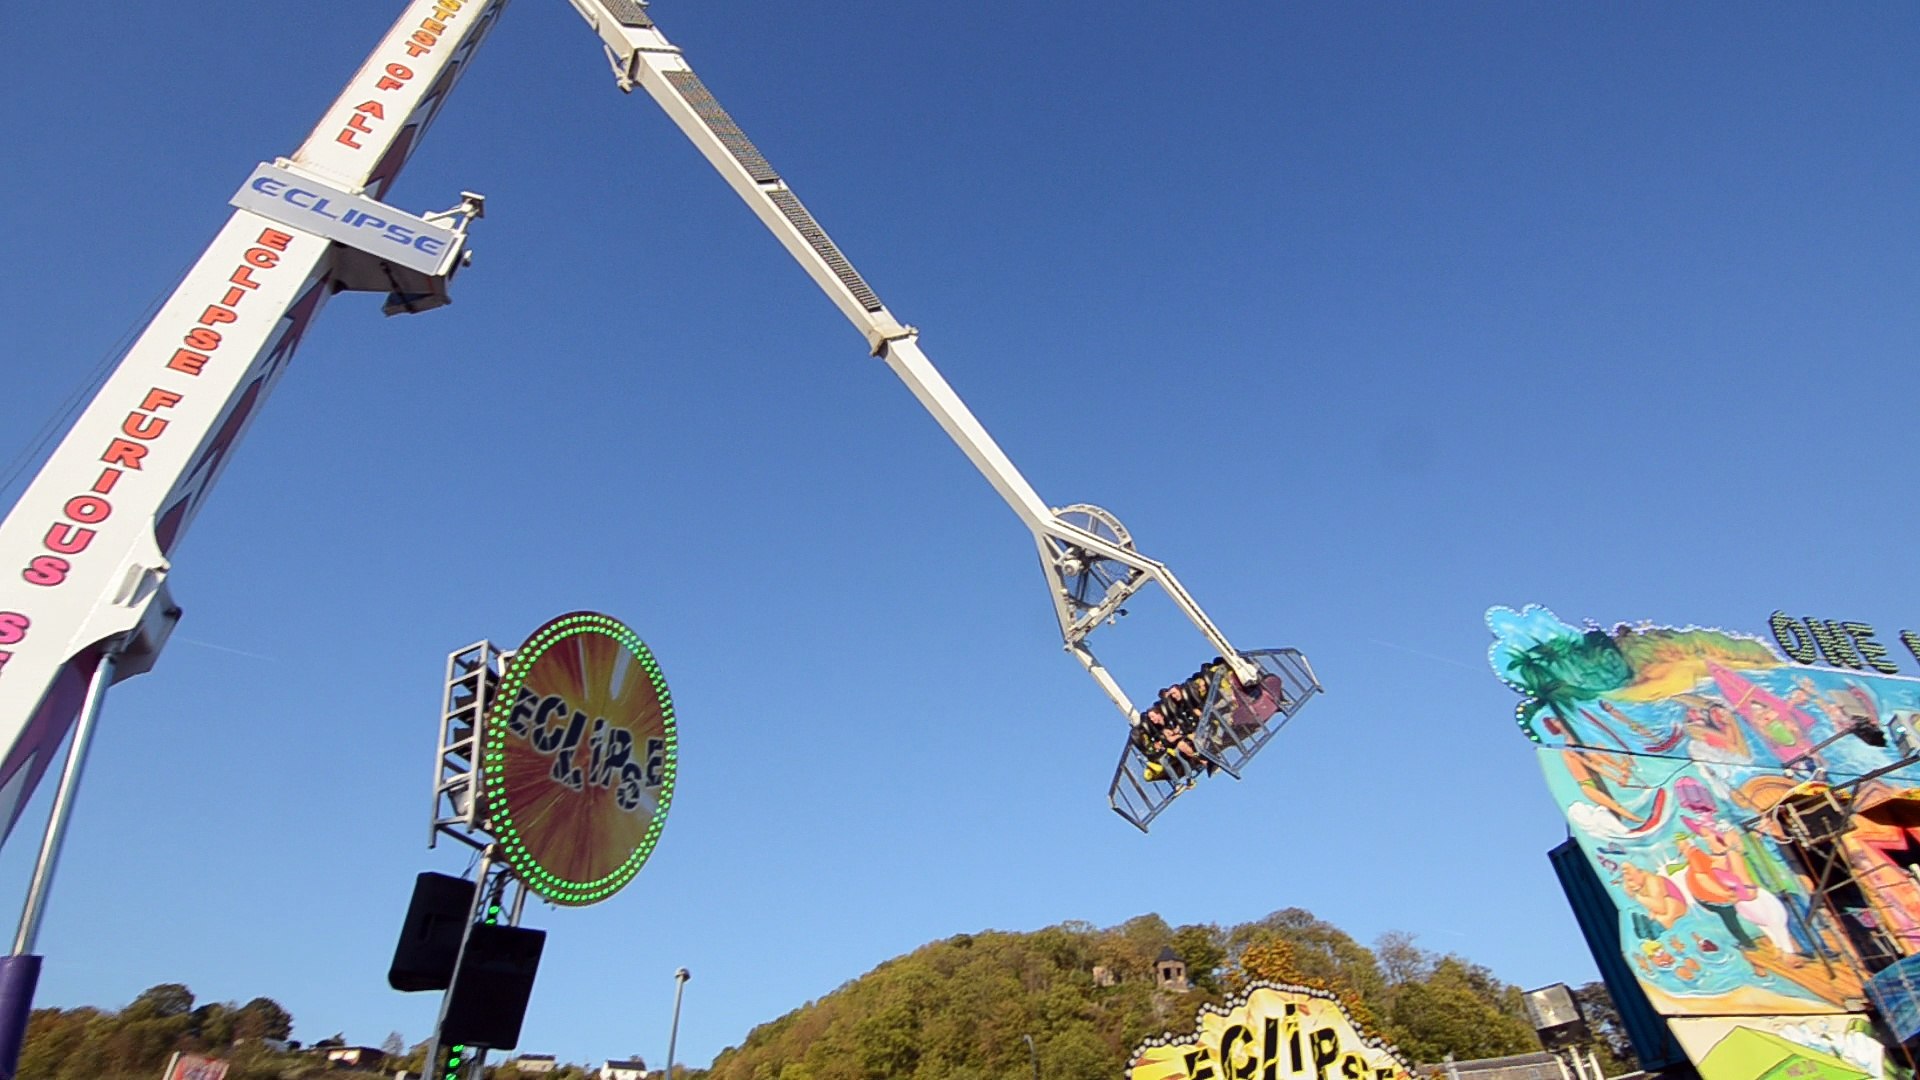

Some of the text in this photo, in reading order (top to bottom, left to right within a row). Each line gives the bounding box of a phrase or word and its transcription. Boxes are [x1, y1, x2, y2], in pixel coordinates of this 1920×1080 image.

[375, 62, 414, 92] OF
[336, 100, 385, 150] ALL
[251, 176, 446, 257] ECLIPSE
[166, 227, 295, 377] ECLIPSE
[22, 386, 185, 587] FURIOUS
